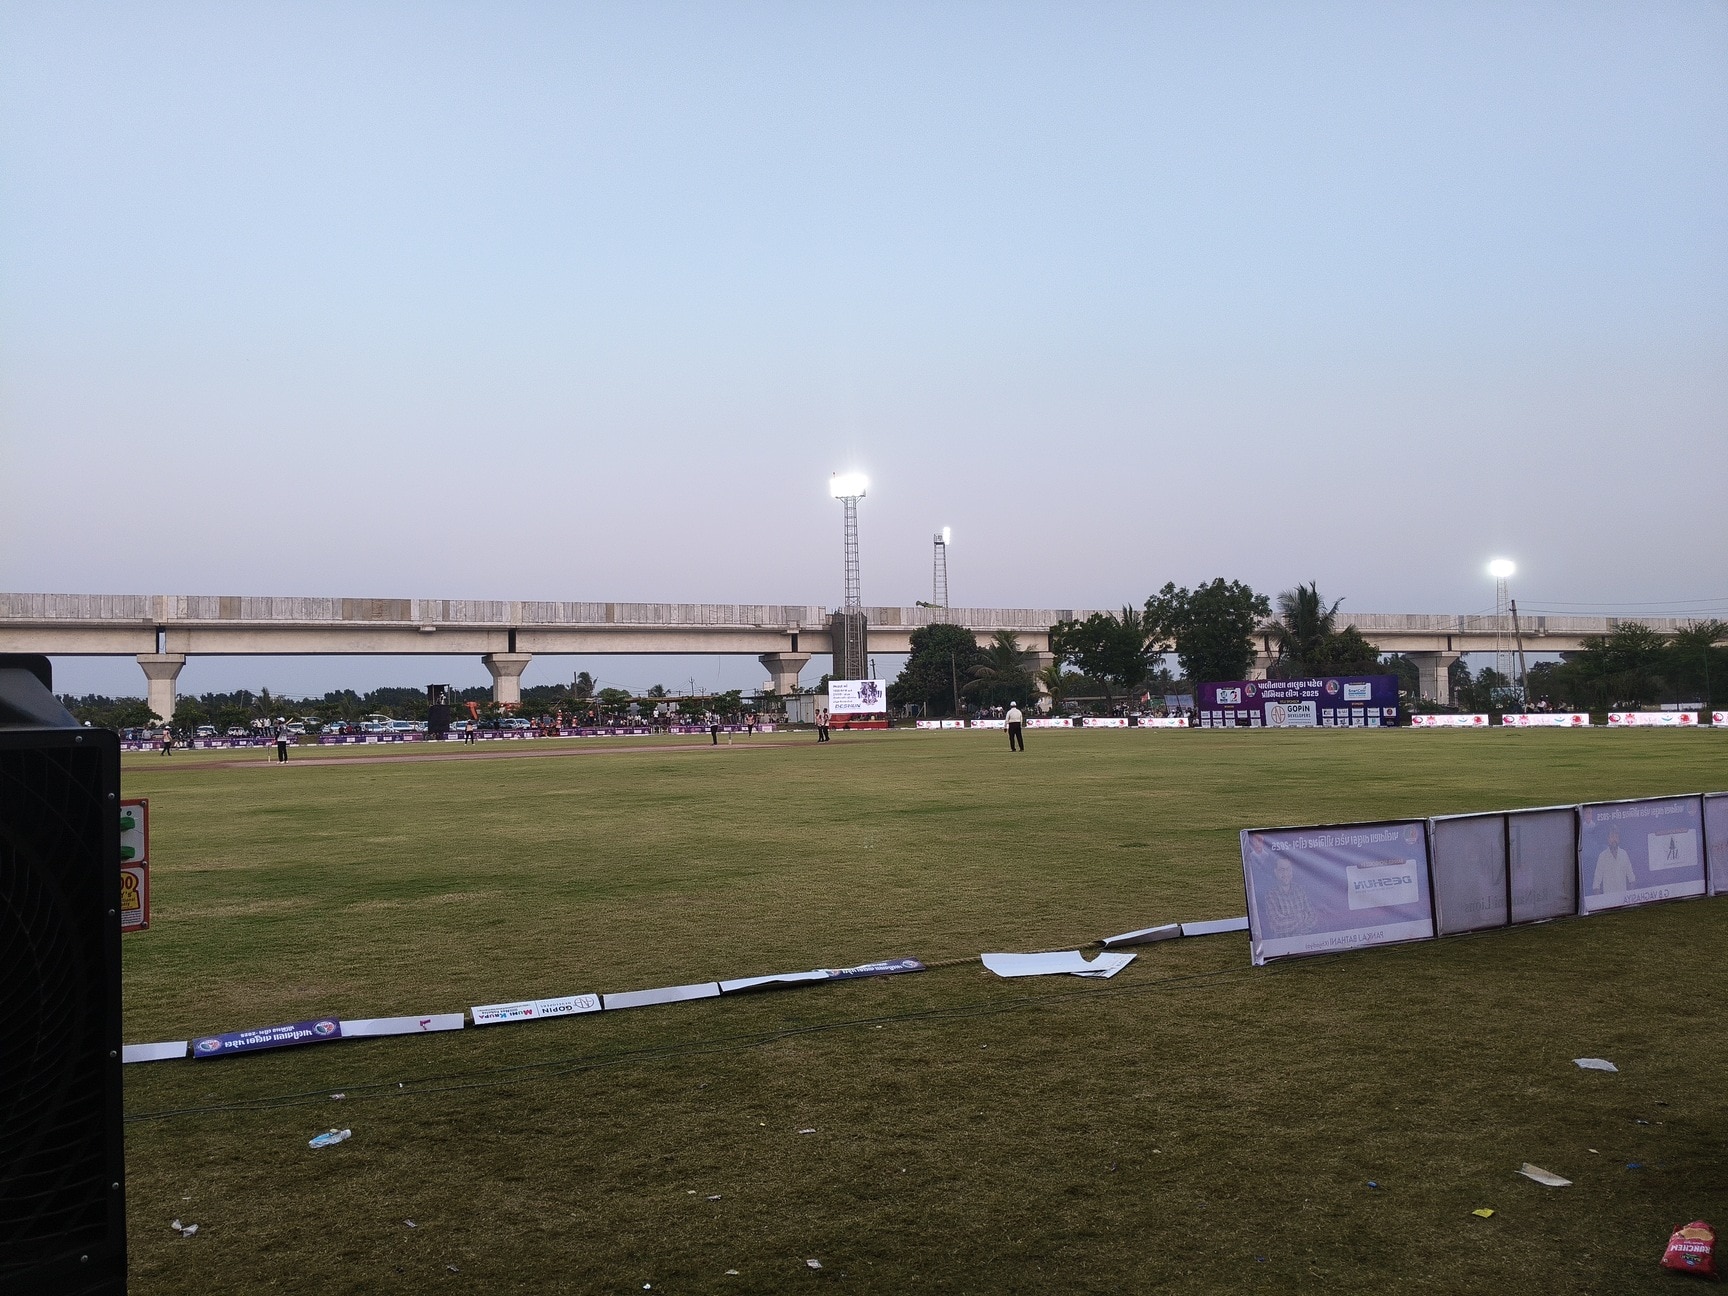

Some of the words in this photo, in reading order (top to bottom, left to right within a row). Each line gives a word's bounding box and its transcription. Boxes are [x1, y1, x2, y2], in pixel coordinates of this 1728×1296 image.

[1258, 680, 1286, 690] પાલીતાણા
[1287, 681, 1306, 690] તાલુકા
[1307, 679, 1322, 687] પટેલ
[542, 1005, 572, 1013] GOPIN
[247, 1034, 271, 1044] તાલુકા
[274, 1029, 312, 1041] પાલીતાણા
[225, 1040, 245, 1048] પટેલ
